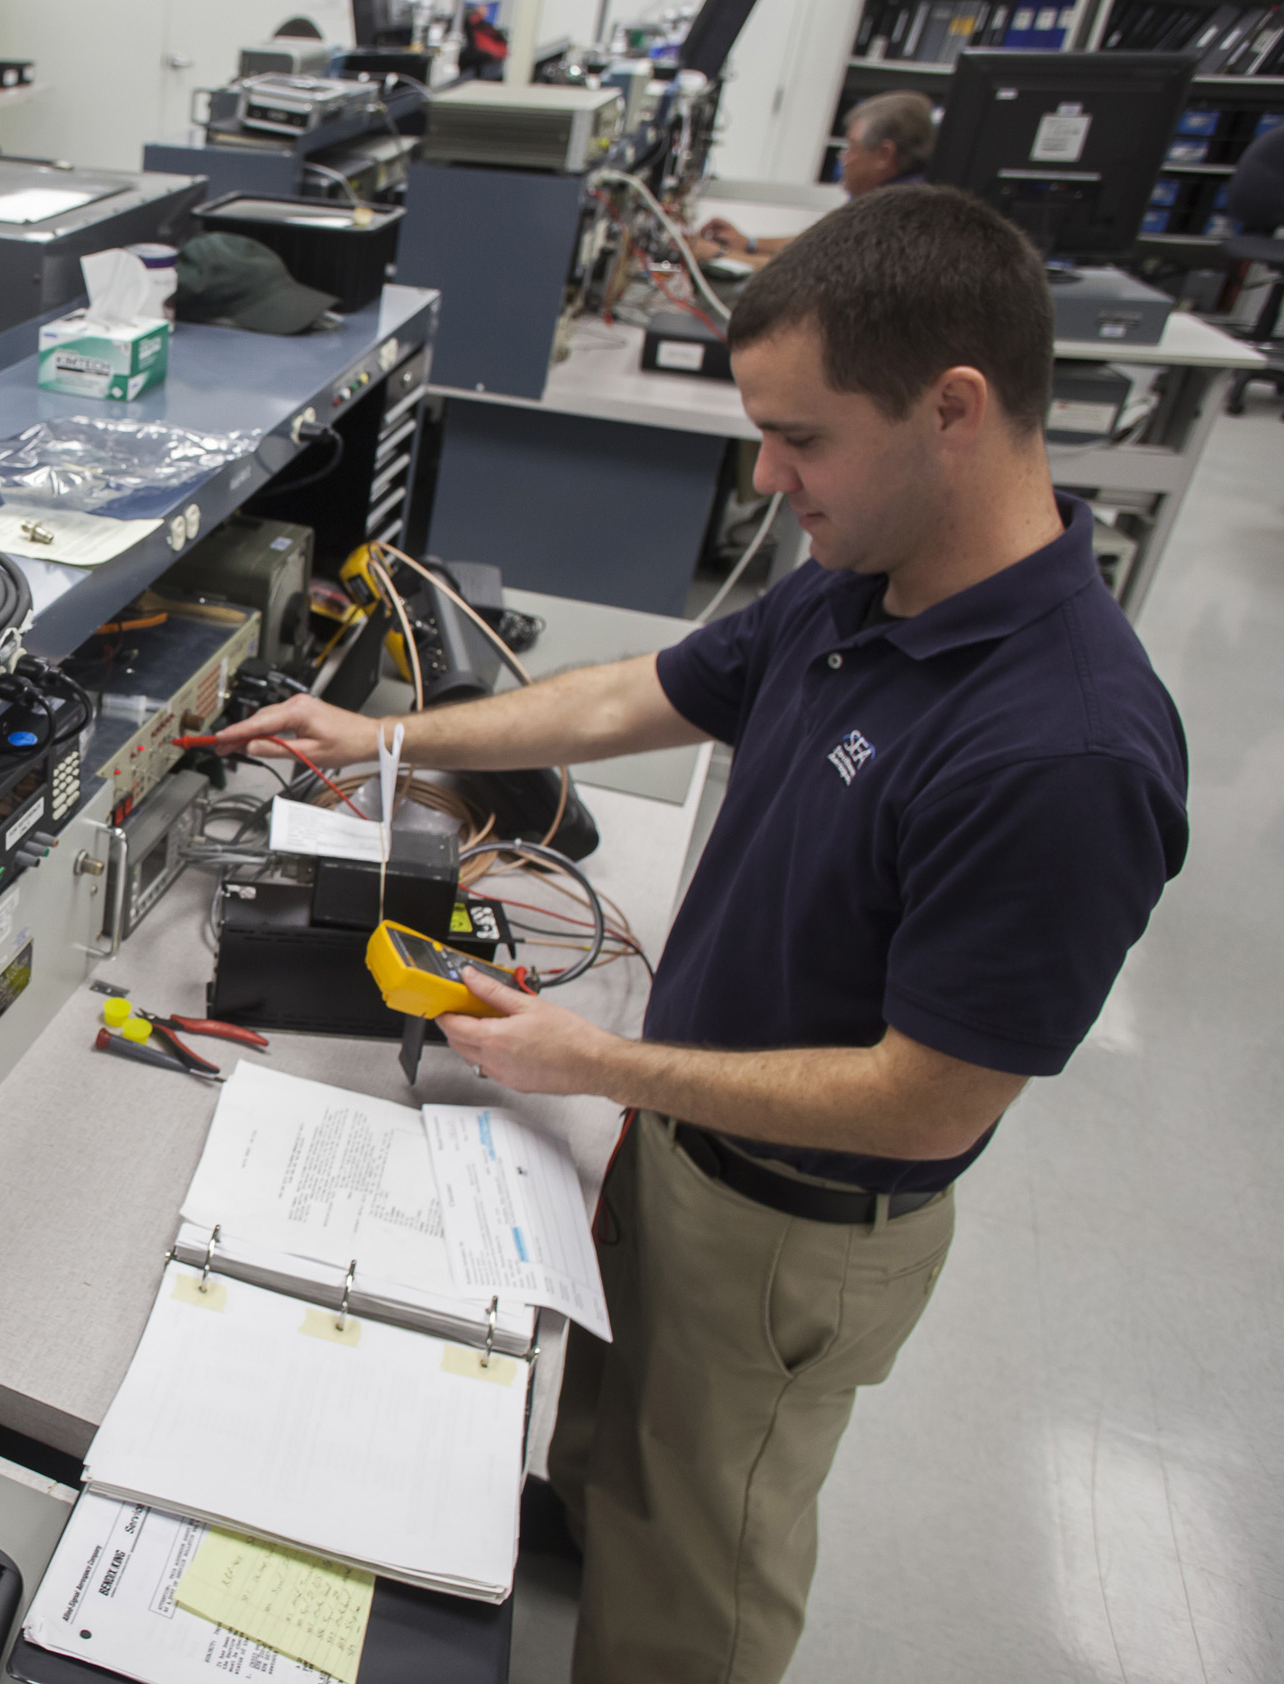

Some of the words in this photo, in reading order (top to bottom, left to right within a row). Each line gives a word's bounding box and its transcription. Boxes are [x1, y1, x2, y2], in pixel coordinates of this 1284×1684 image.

[62, 1590, 80, 1622] Allied-Signal
[76, 1566, 92, 1590] Aerospace
[87, 1545, 103, 1566] Company
[98, 1569, 117, 1596] BENDIX
[114, 1550, 126, 1569] KING
[125, 1504, 145, 1534] Servic
